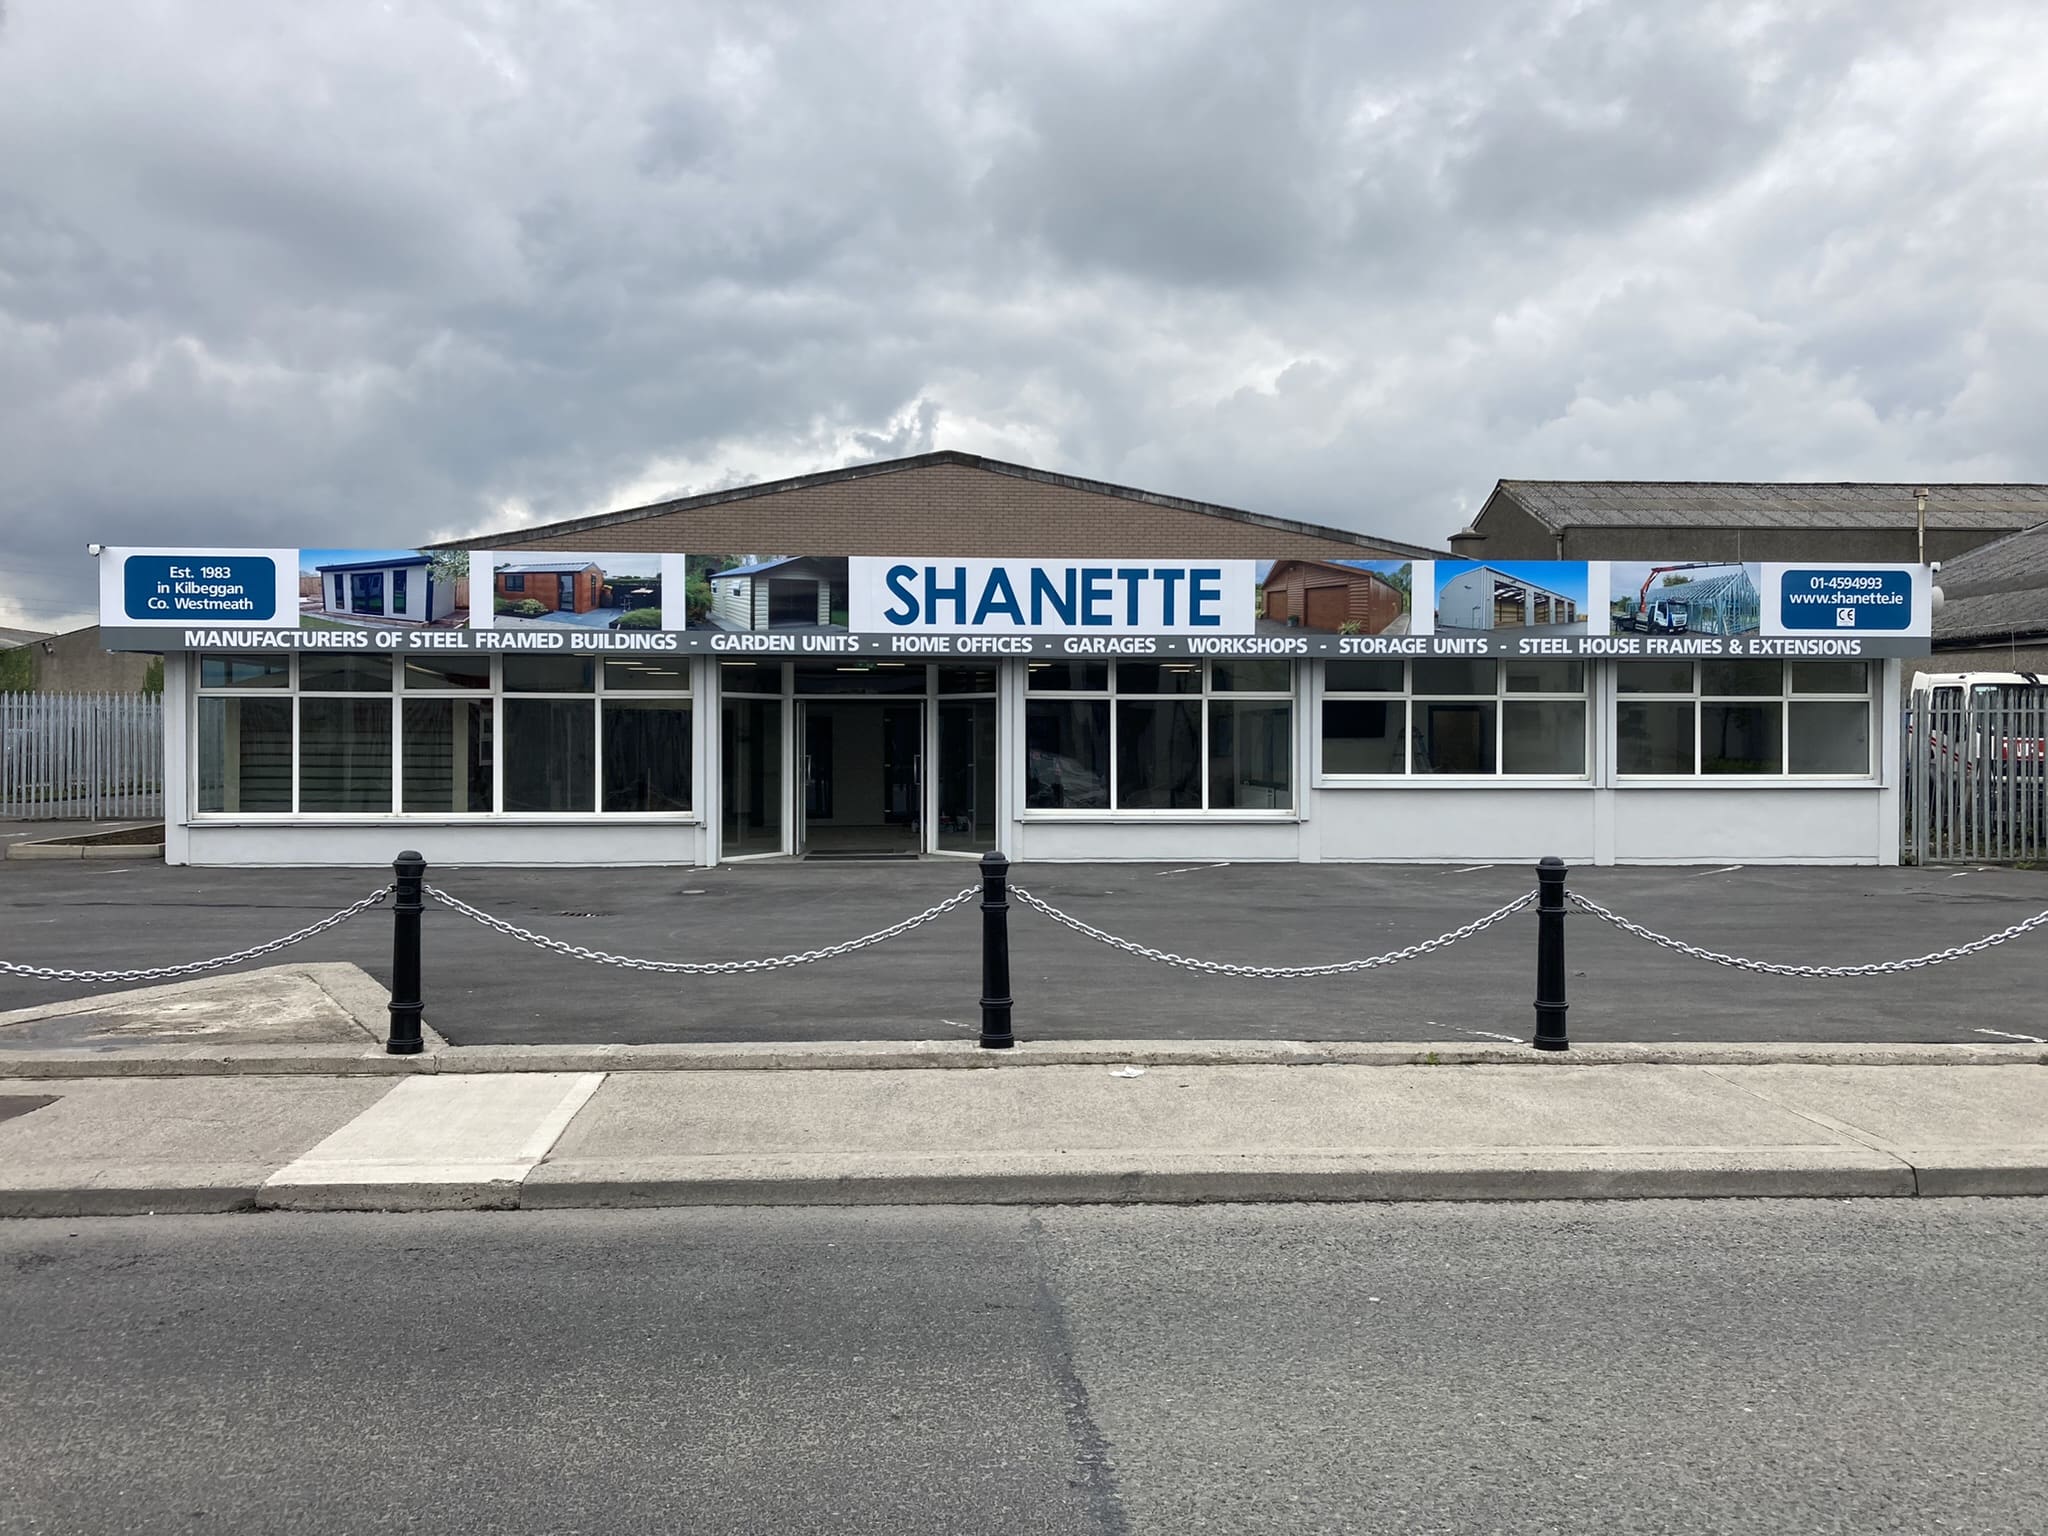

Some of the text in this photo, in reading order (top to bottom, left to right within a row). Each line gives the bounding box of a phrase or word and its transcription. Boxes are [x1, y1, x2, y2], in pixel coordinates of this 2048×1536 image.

[170, 566, 231, 579] Est. 1983
[157, 581, 244, 598] in Kilbeggan
[1810, 576, 1883, 590] 01-4594993
[147, 597, 253, 611] Co. Westmeath
[884, 565, 1221, 628] SHANETTE
[1789, 590, 1904, 605] www.shanette.ie
[184, 630, 369, 649] MANUFACTURERS
[375, 631, 402, 649] OF
[409, 632, 468, 650] STEEL
[475, 633, 564, 651] FRAMED
[570, 633, 678, 651] BUILDINGS
[710, 634, 795, 652] GARDEN
[802, 635, 860, 653] UNITS
[891, 635, 950, 653] HOME
[956, 636, 1033, 654] OFFICES
[1063, 636, 1157, 654] GARAGES
[1187, 637, 1308, 655] WORKSHOPS
[1339, 637, 1427, 655] STORAGE
[1433, 638, 1488, 656] UNITS
[1519, 637, 1573, 656] STEEL
[1579, 638, 1640, 656] HOUSE
[1646, 638, 1723, 656] FRAMES
[1728, 638, 1743, 656] &
[1749, 638, 1862, 656] EXTENSIONS
